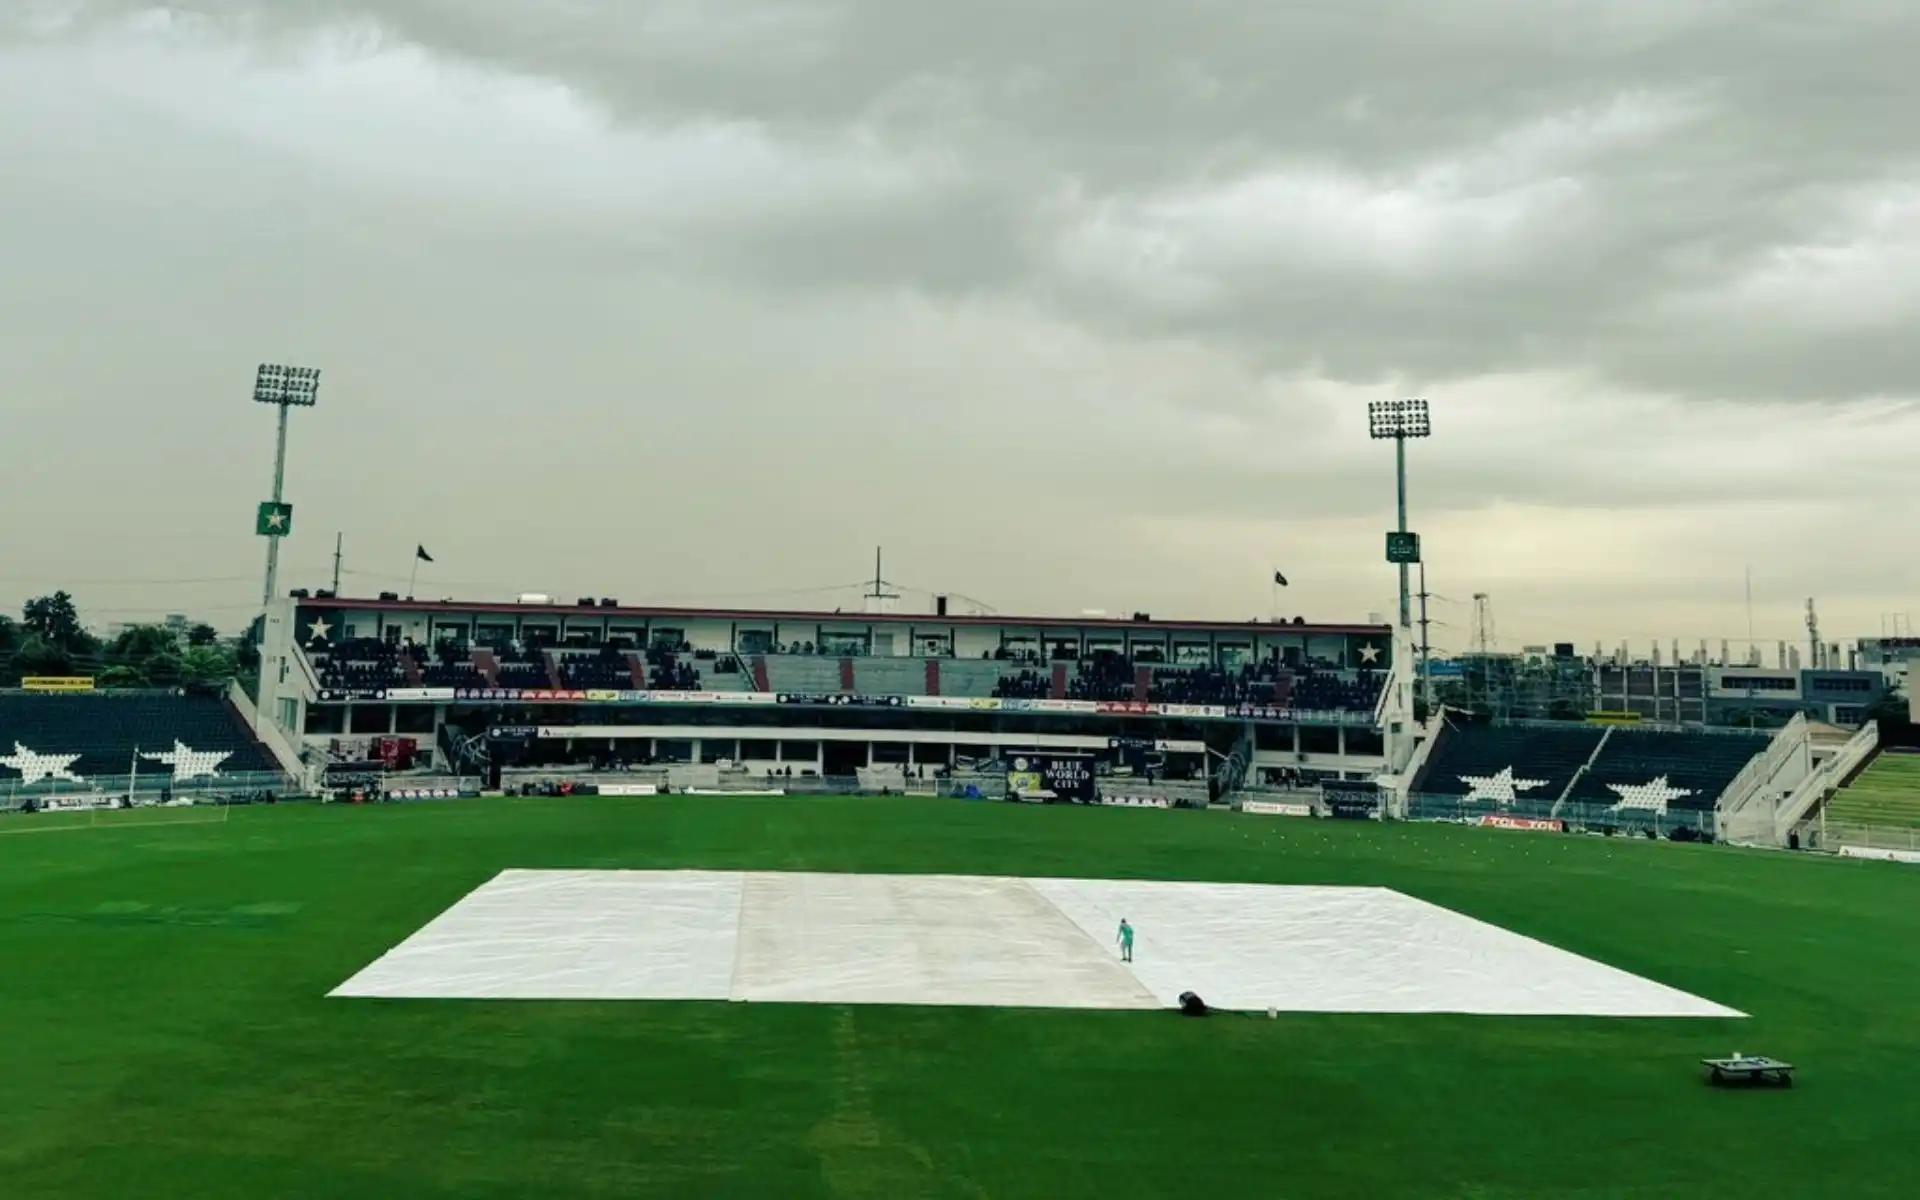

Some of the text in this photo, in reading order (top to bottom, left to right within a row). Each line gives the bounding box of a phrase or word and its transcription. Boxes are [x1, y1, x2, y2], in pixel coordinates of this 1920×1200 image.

[1051, 760, 1084, 769] BLUE
[1045, 769, 1090, 780] WORLD
[1053, 779, 1081, 788] CITY
[1490, 816, 1558, 832] TCL TCL
